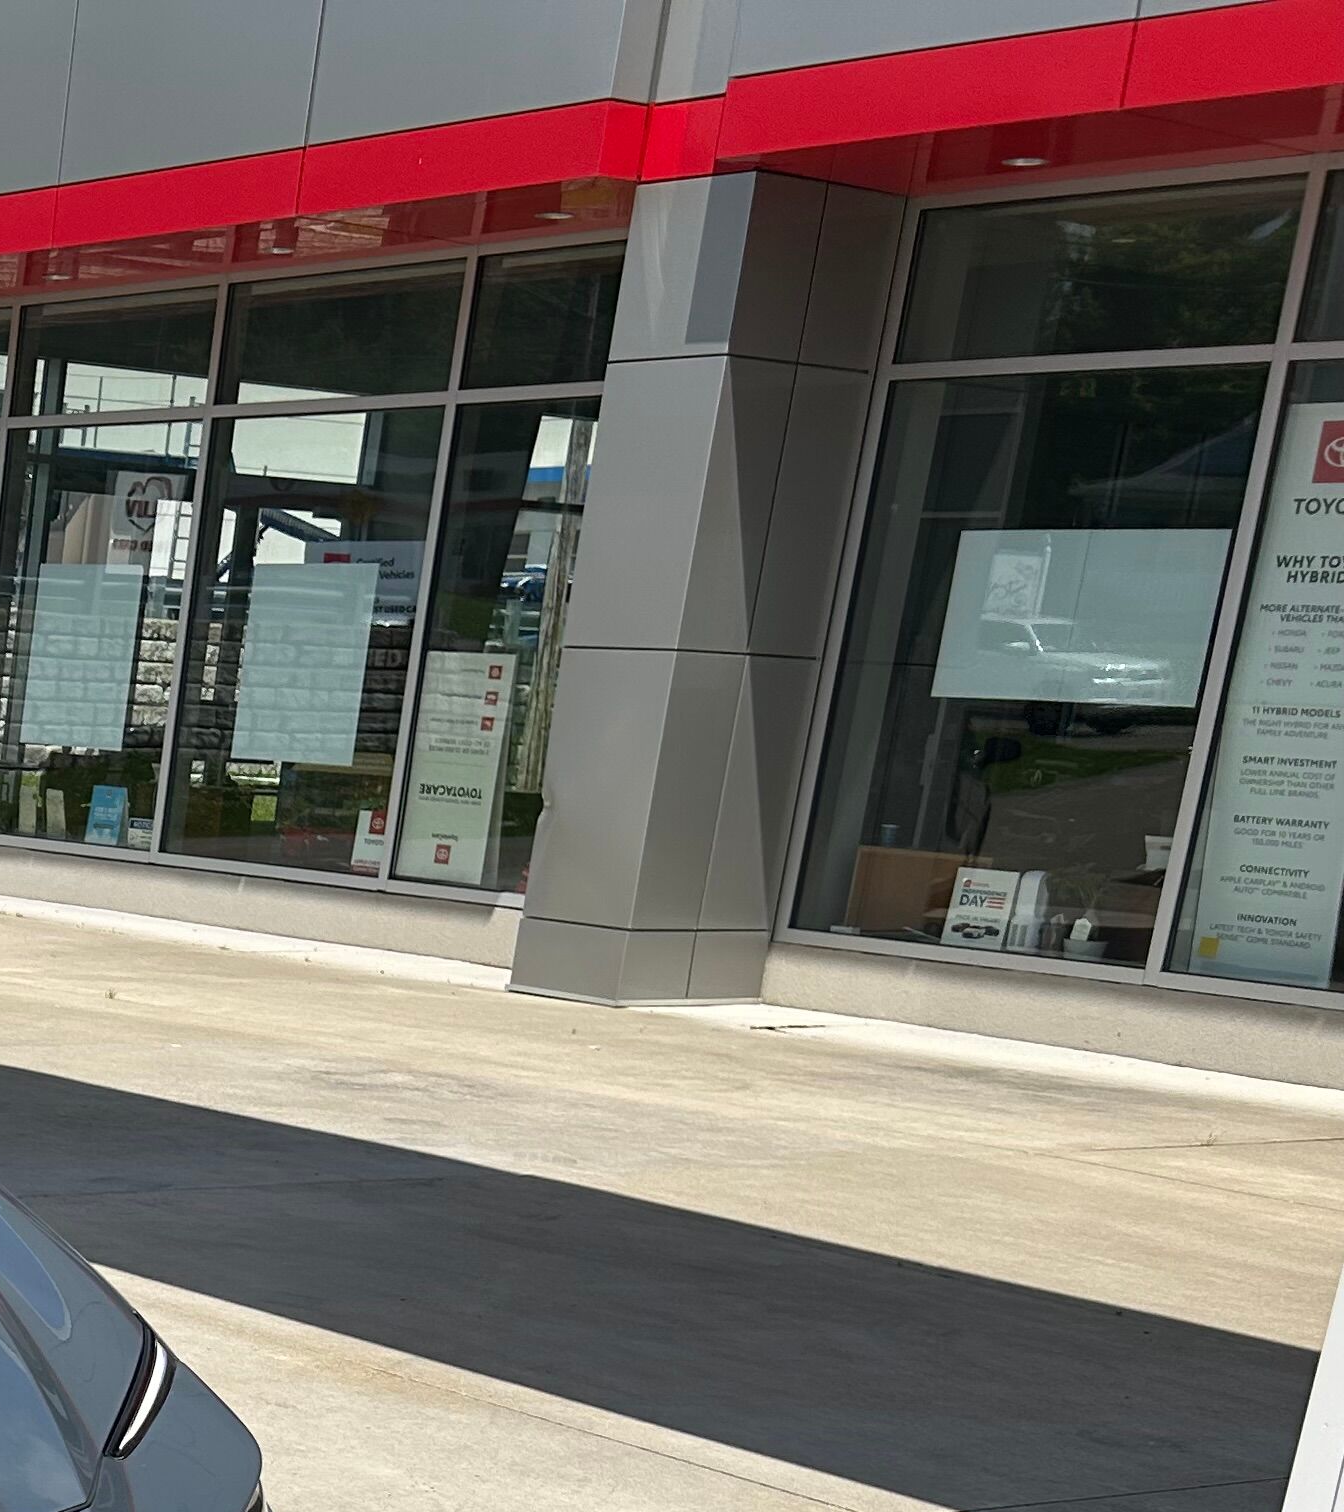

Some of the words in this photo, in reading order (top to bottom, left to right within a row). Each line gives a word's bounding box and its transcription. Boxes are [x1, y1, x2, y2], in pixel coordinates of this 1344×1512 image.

[1277, 555, 1315, 568] WHY
[1320, 555, 1344, 568] TO
[1260, 604, 1288, 612] MORE
[1280, 614, 1323, 623] VEHICLES
[1266, 678, 1292, 687] CHEVY
[1263, 706, 1297, 716] HYBRID
[1301, 708, 1341, 718] MODELS
[1242, 755, 1275, 764] SMART
[1276, 757, 1337, 769] INVESTMENT
[419, 783, 482, 799] TOYOTACARE
[1233, 814, 1273, 825] BATTERY
[1275, 817, 1329, 829] WARRANTY
[1239, 864, 1310, 879] CONNECTIVITY
[959, 893, 988, 908] DAY
[1236, 913, 1297, 927] INNOVATION
